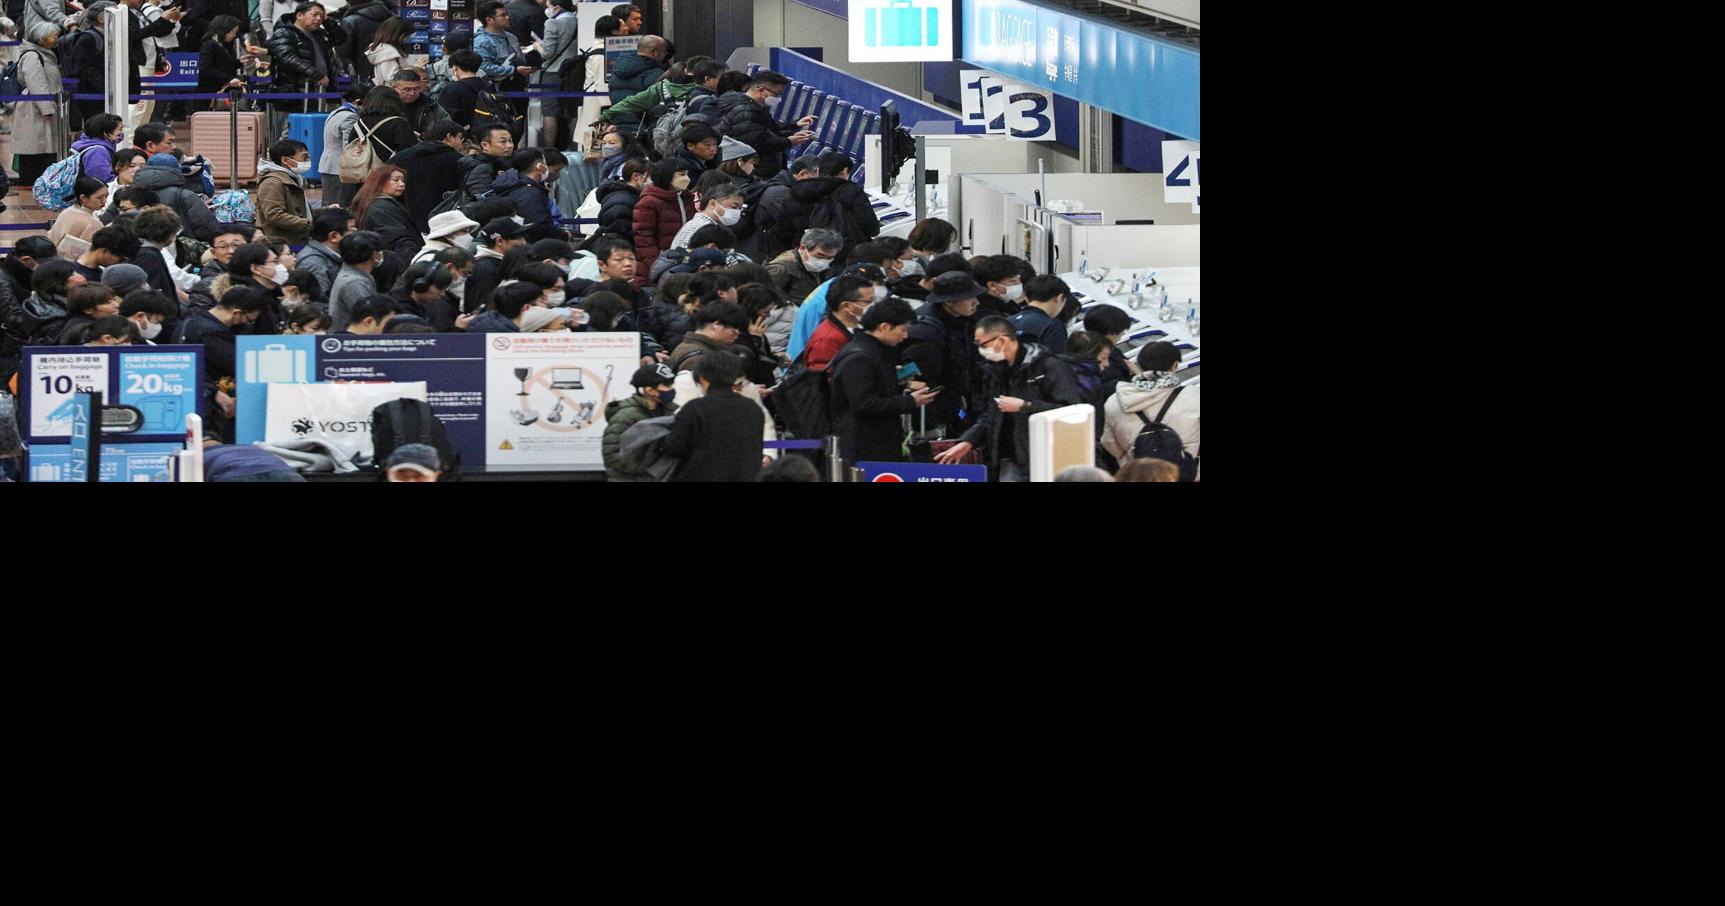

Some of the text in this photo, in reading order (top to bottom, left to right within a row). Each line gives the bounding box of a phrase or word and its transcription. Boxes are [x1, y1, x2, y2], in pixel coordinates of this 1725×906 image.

[1009, 92, 1051, 138] 3
[1166, 154, 1191, 187] 4
[40, 375, 73, 394] 10
[75, 383, 94, 393] kg
[126, 373, 162, 394] 20
[163, 382, 183, 395] kg
[318, 421, 371, 433] YOST
